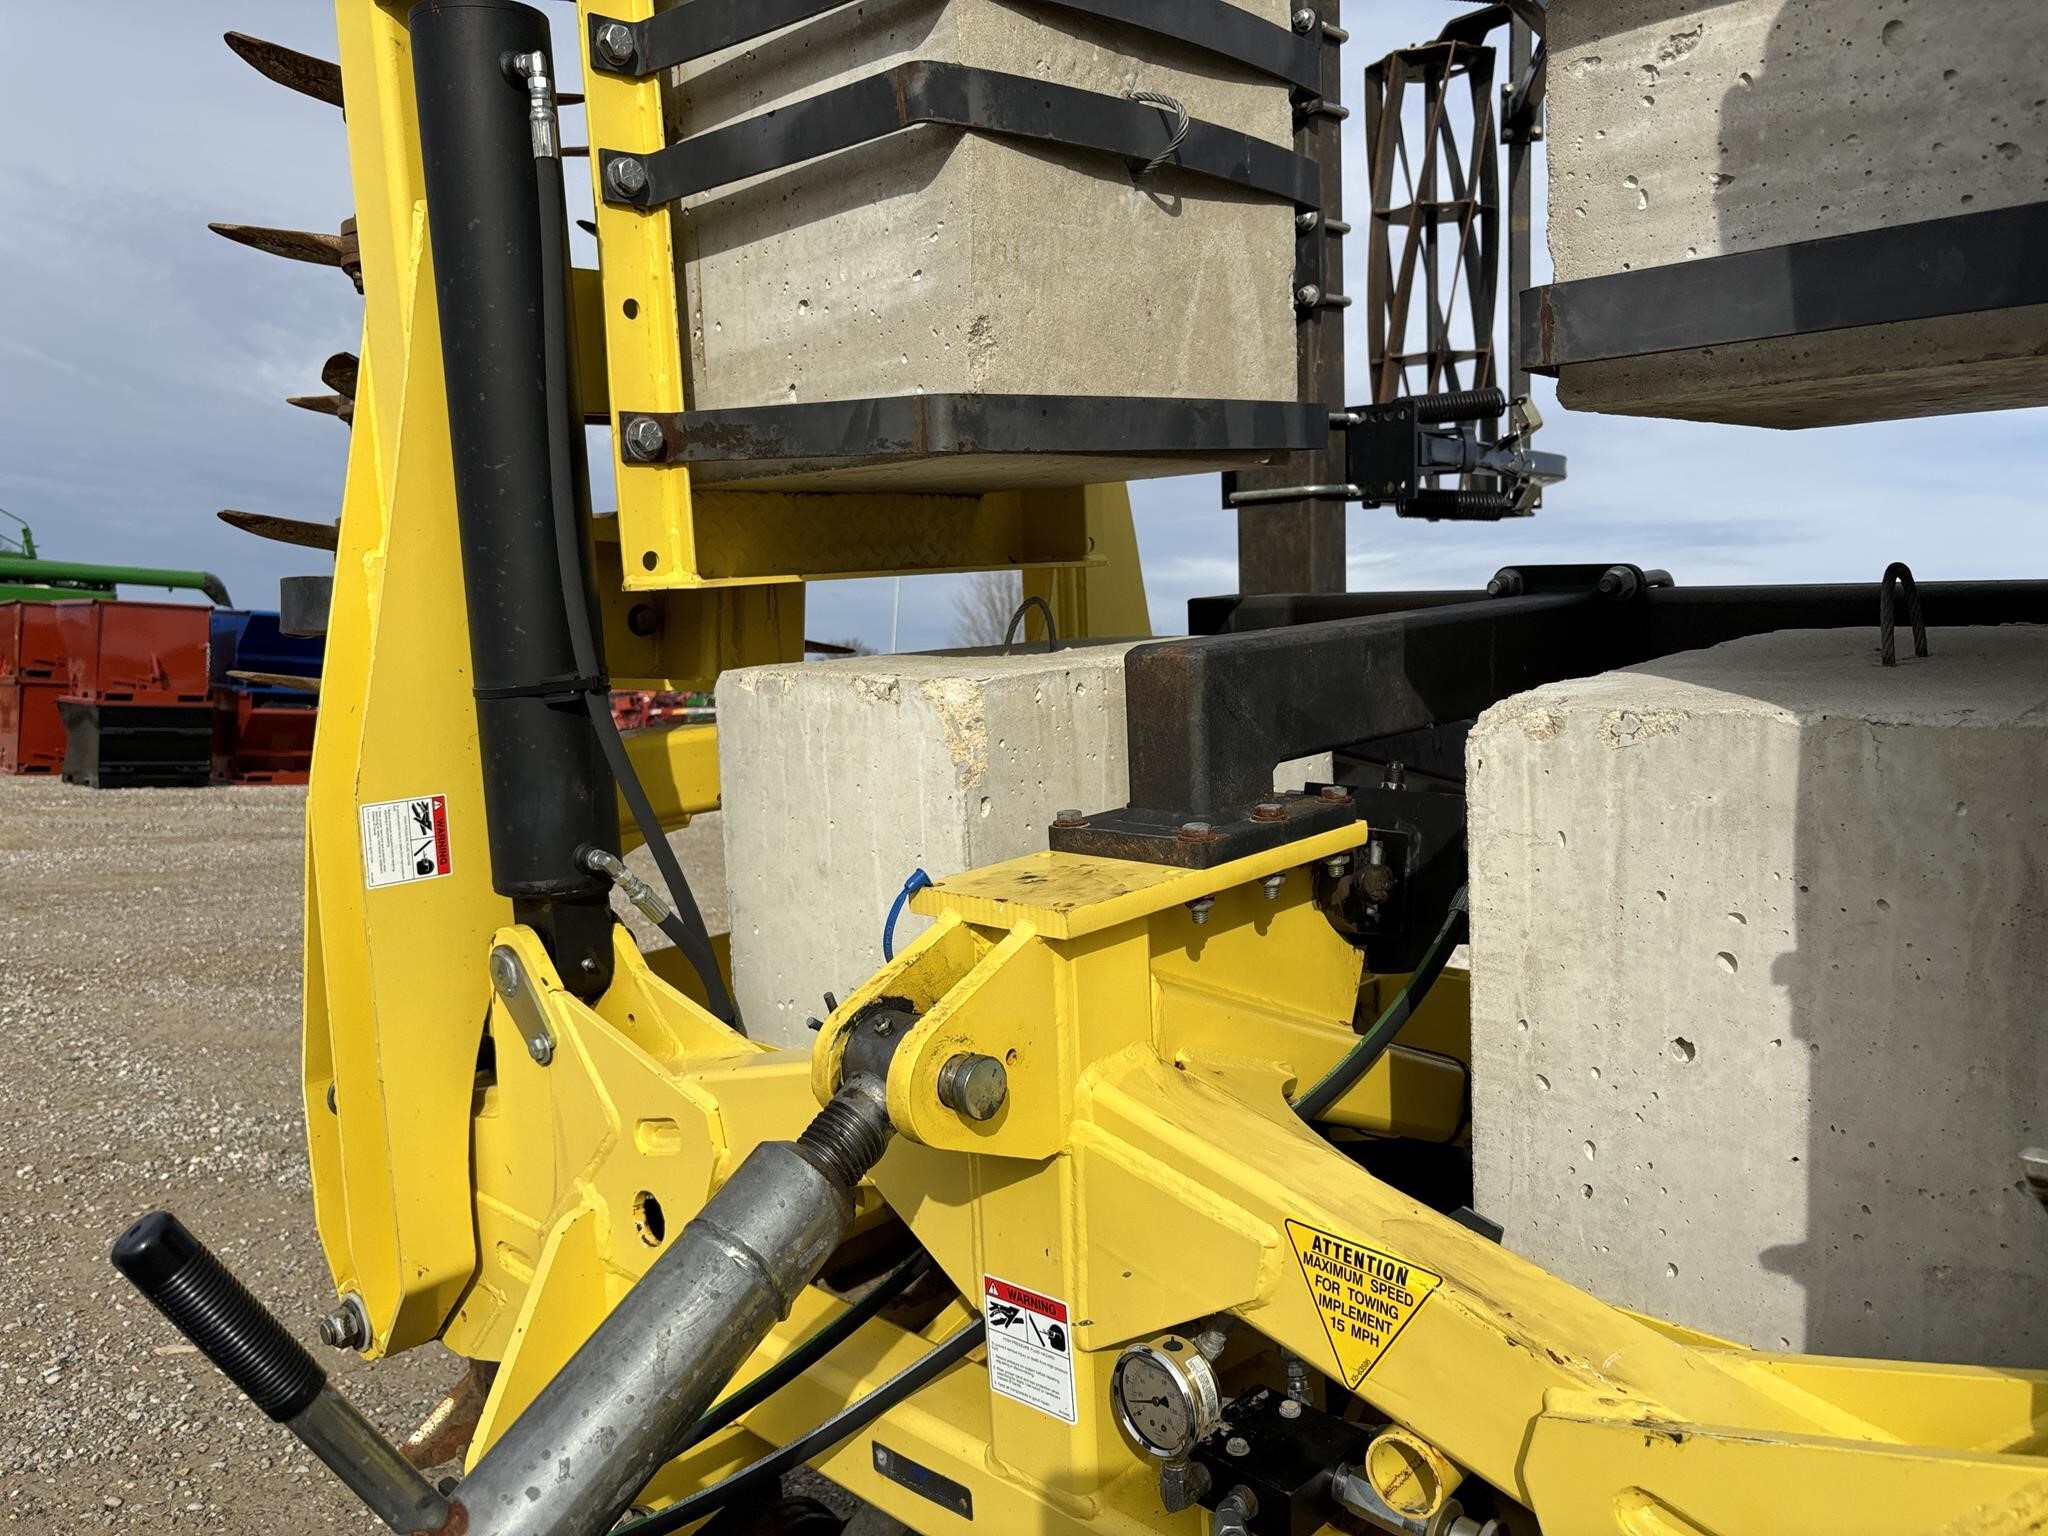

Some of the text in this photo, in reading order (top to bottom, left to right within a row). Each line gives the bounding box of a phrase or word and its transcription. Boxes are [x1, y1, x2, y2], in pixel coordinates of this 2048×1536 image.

[437, 818, 447, 865] WARNING
[1303, 1251, 1414, 1308] MAXIMUM SPEED
[1312, 1235, 1409, 1286] ATTENTION
[1007, 1288, 1057, 1316] WARNING
[1315, 1274, 1399, 1320] FOR TOWING
[1319, 1294, 1392, 1335] IMPLEMENT
[1330, 1316, 1379, 1348] 15 MPH
